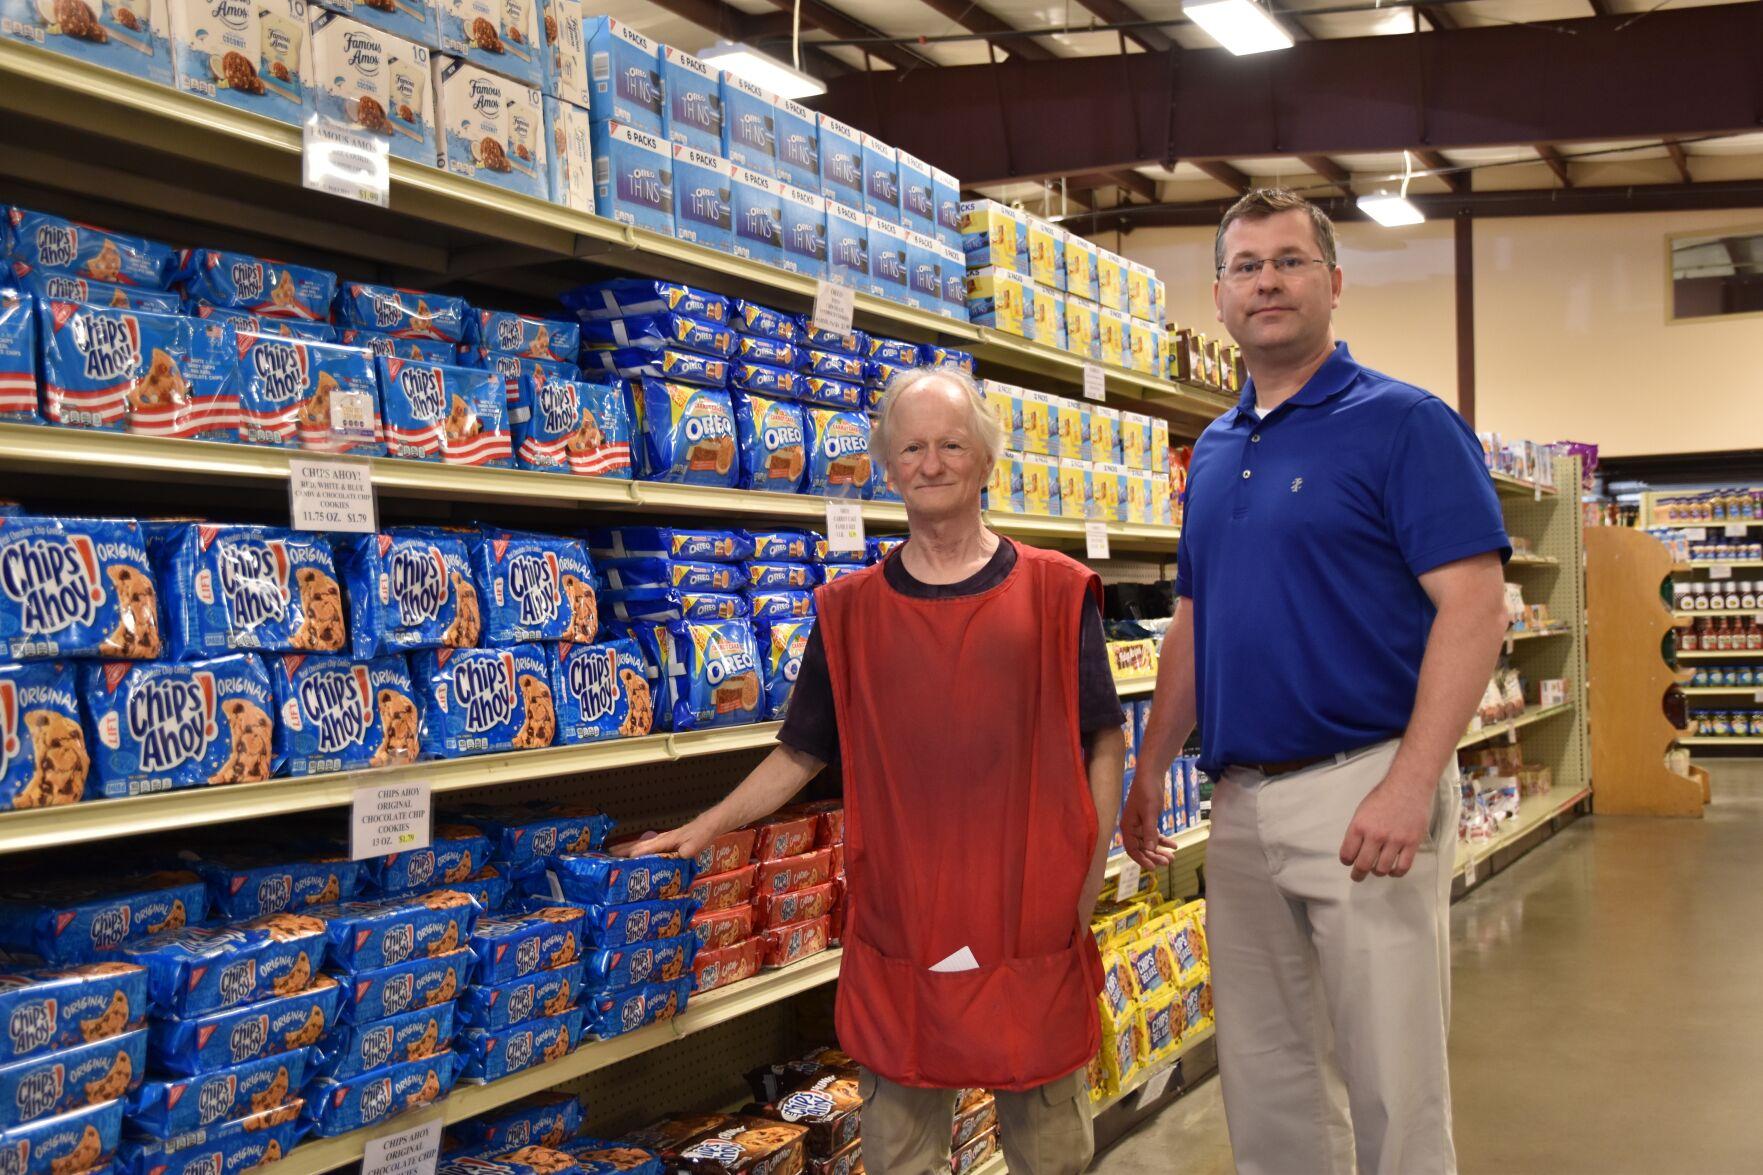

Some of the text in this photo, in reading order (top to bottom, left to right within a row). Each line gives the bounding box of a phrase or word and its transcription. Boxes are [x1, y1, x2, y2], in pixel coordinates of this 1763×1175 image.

[212, 1, 248, 18] Amos
[343, 32, 382, 53] Famous
[629, 30, 647, 49] PACKS
[348, 53, 380, 67] Amos
[412, 46, 426, 62] 10
[687, 57, 707, 74] PACKS
[469, 79, 501, 98] Famous
[528, 90, 539, 104] 10
[625, 72, 651, 103] THNS
[473, 96, 498, 109] Amos
[682, 97, 710, 126] THNS
[633, 132, 656, 149] PACKS
[740, 118, 765, 146] THNS
[696, 153, 716, 168] PACKS
[628, 174, 660, 203] THNS
[750, 174, 768, 188] PACKS
[691, 194, 719, 220] THNS
[745, 212, 771, 238] THNS
[685, 416, 732, 440] OREO
[765, 427, 801, 450] OREO
[825, 437, 868, 458] OREO
[302, 467, 361, 480] CHIPS AHOY!
[318, 482, 338, 490] WHITE
[322, 492, 356, 500] CHOCOLATE
[320, 501, 349, 509] COOKIES
[303, 512, 324, 521] 11.75
[347, 513, 367, 523] $1.79
[2, 541, 81, 597] Chips
[393, 553, 437, 592] Chips
[510, 556, 549, 598] Chips
[516, 658, 548, 678] ORIGINAL
[571, 651, 609, 694] Chips
[706, 654, 753, 686] OREO
[455, 658, 505, 702] Chips
[19, 688, 78, 713] ORIGINAL
[218, 679, 267, 703] ORIGINAL
[302, 672, 357, 720] Chips
[130, 681, 201, 737] Chips
[109, 718, 117, 745] LIFT
[378, 787, 420, 799] CHIPS AHOY
[377, 800, 412, 810] ORIGINAL
[362, 810, 425, 824] CHOCOLATE CHIP
[378, 823, 410, 834] COOKIES
[11, 1006, 48, 1037] Chips
[1152, 1014, 1169, 1033] CHIPS
[18, 1070, 56, 1103] Chips
[384, 1128, 430, 1150] CHIPS AHOY
[367, 1156, 417, 1175] CHOCOLATE
[418, 1148, 437, 1162] CHIP
[386, 1142, 423, 1161] ORIGINAL
